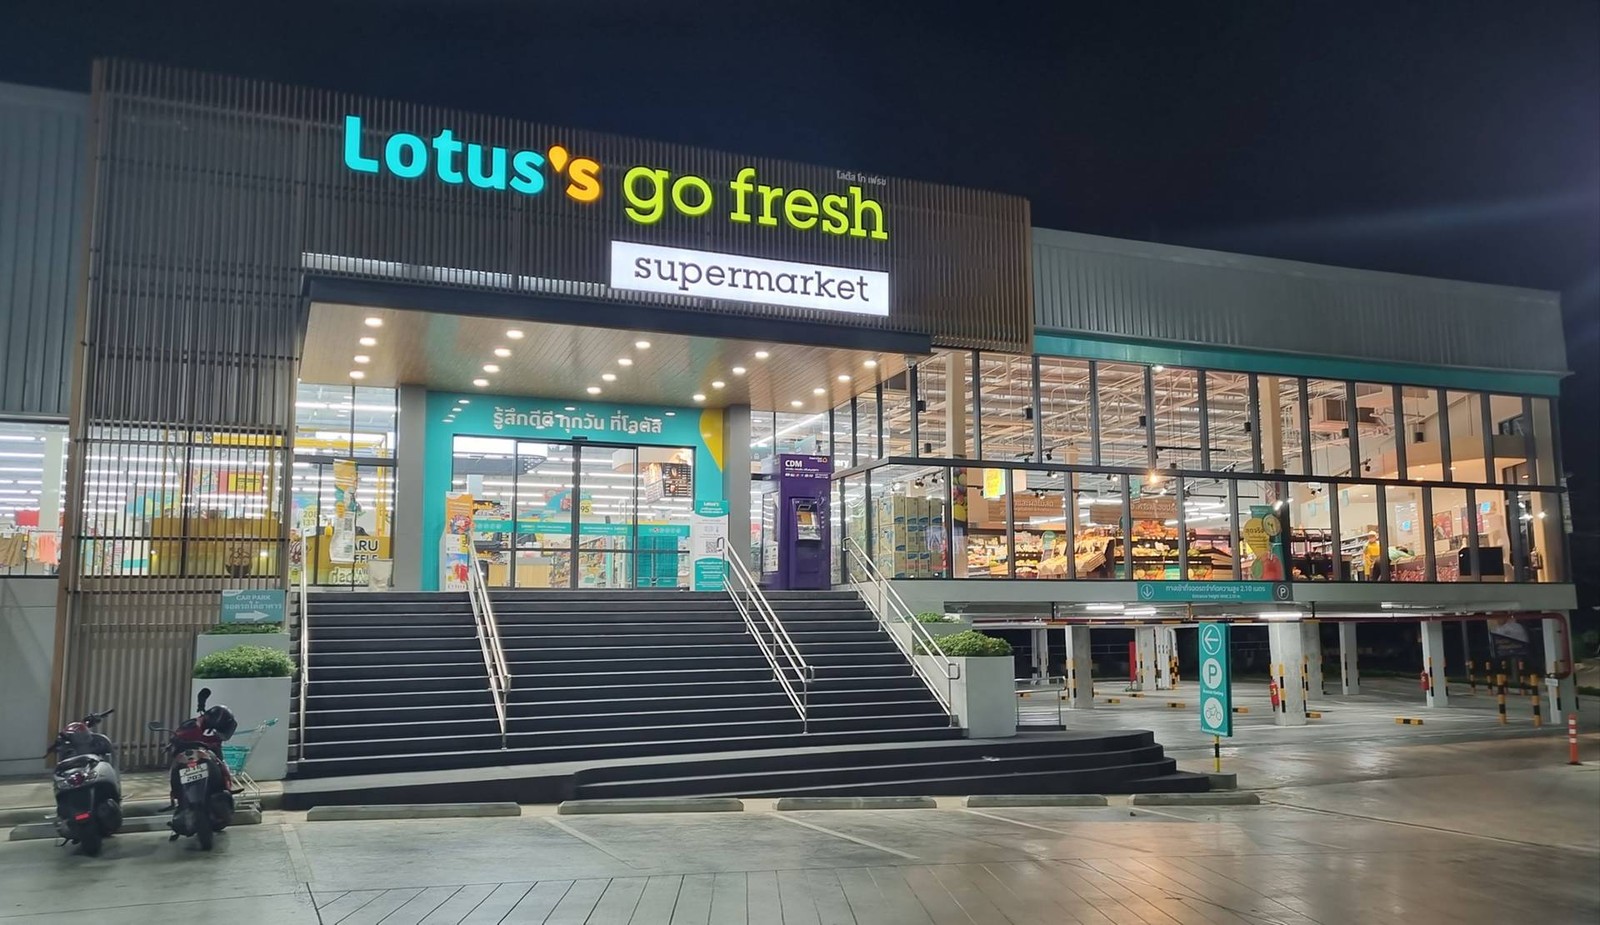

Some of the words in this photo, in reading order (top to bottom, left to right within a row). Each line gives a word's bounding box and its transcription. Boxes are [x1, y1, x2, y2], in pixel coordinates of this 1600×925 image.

[345, 115, 602, 203] Lotus's
[623, 166, 713, 224] go
[730, 167, 889, 240] fresh
[634, 256, 870, 302] supermarket
[558, 412, 605, 433] ทุกวัน
[1208, 663, 1218, 684] P
